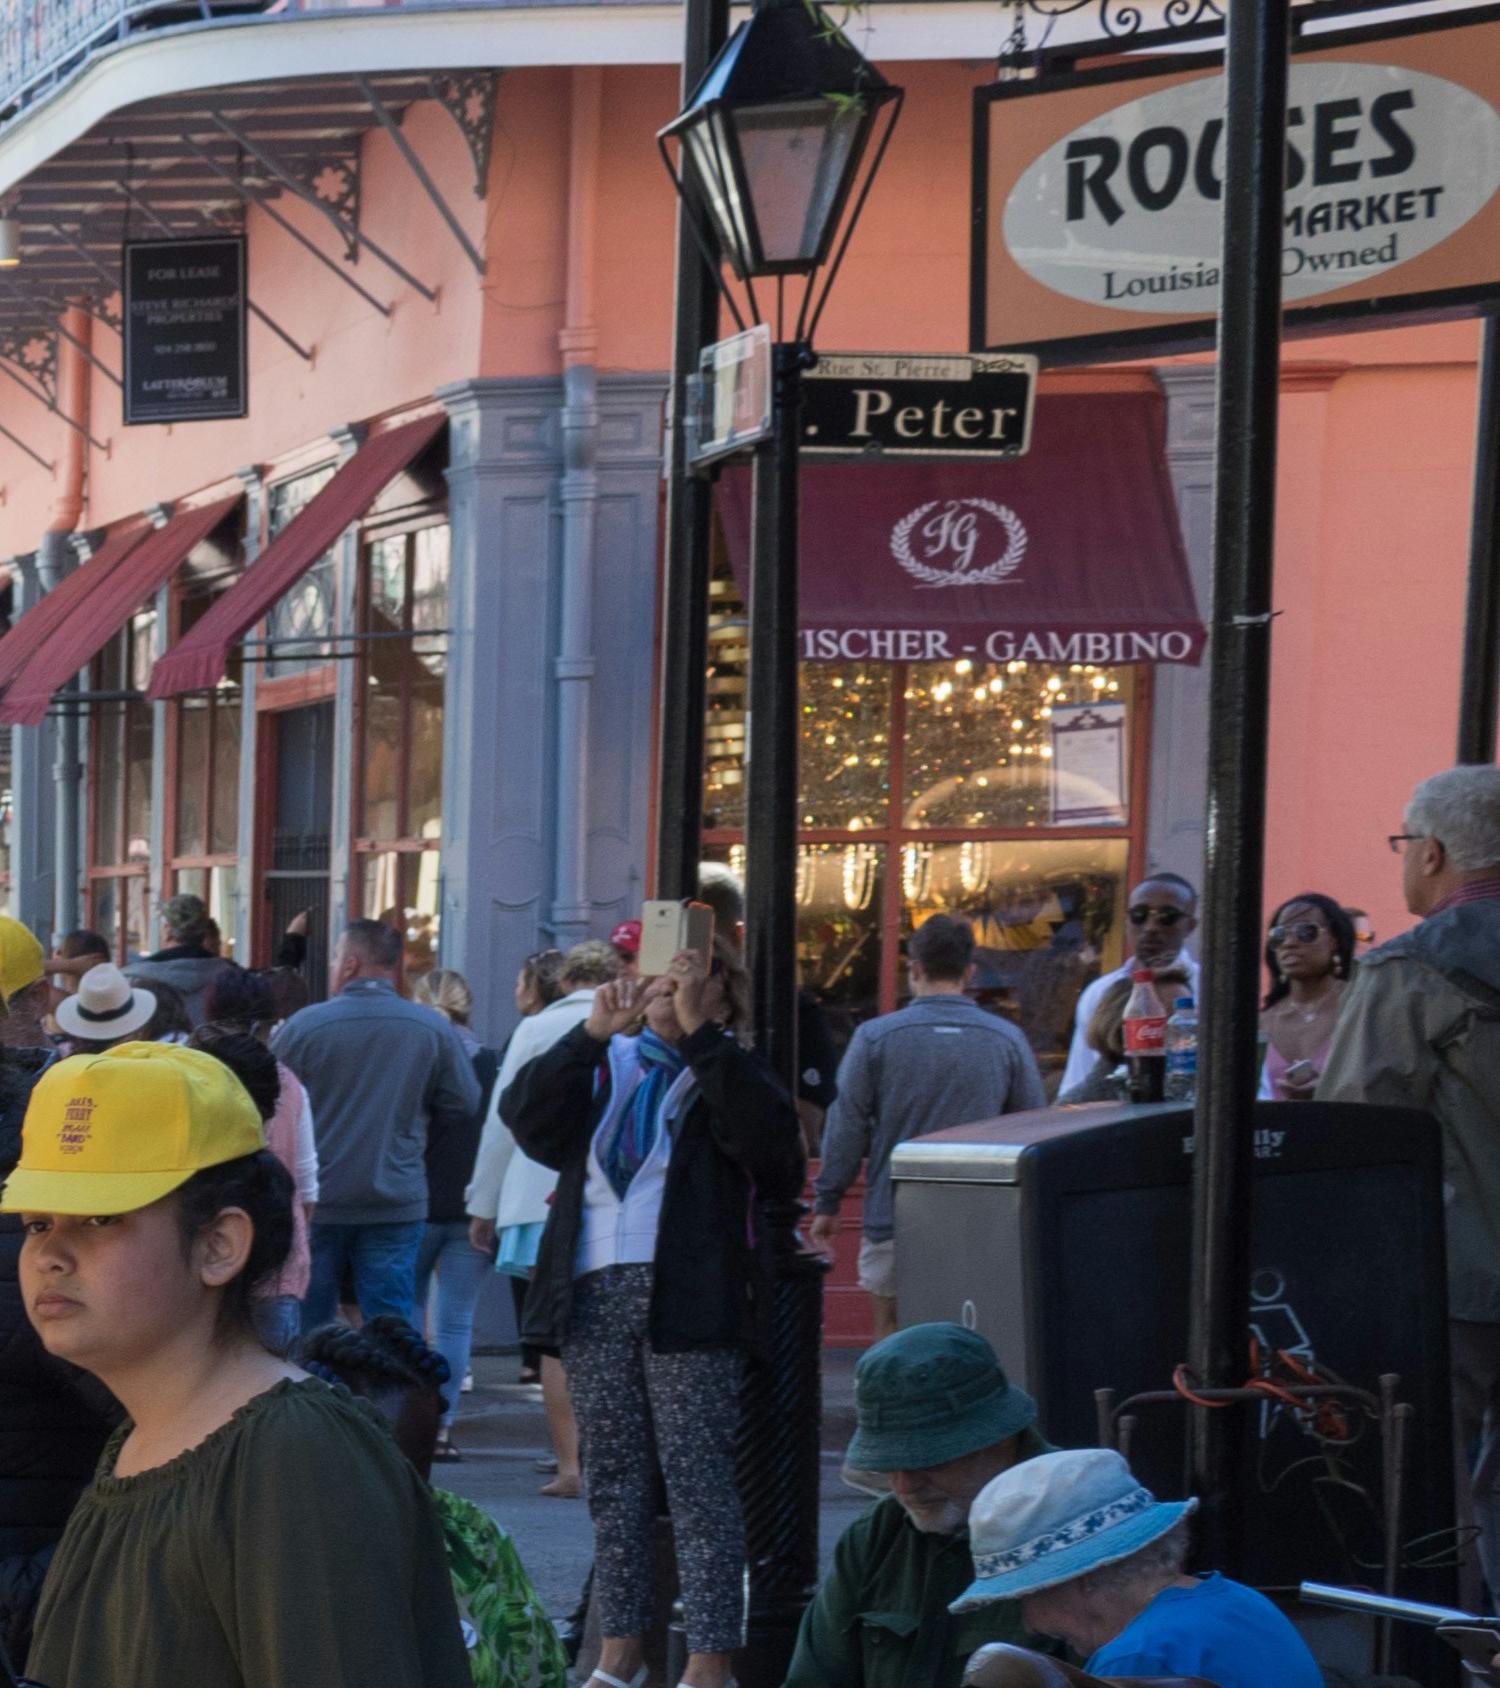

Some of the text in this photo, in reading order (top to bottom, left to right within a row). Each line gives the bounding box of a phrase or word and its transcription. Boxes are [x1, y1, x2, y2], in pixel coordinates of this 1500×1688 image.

[148, 269, 176, 280] FOR
[1104, 262, 1221, 300] Louisia
[818, 360, 855, 376] Rue
[894, 358, 951, 377] Pierre
[849, 389, 1018, 440] Peter
[801, 630, 955, 660] ISCHER
[985, 631, 1192, 663] GAMBINO
